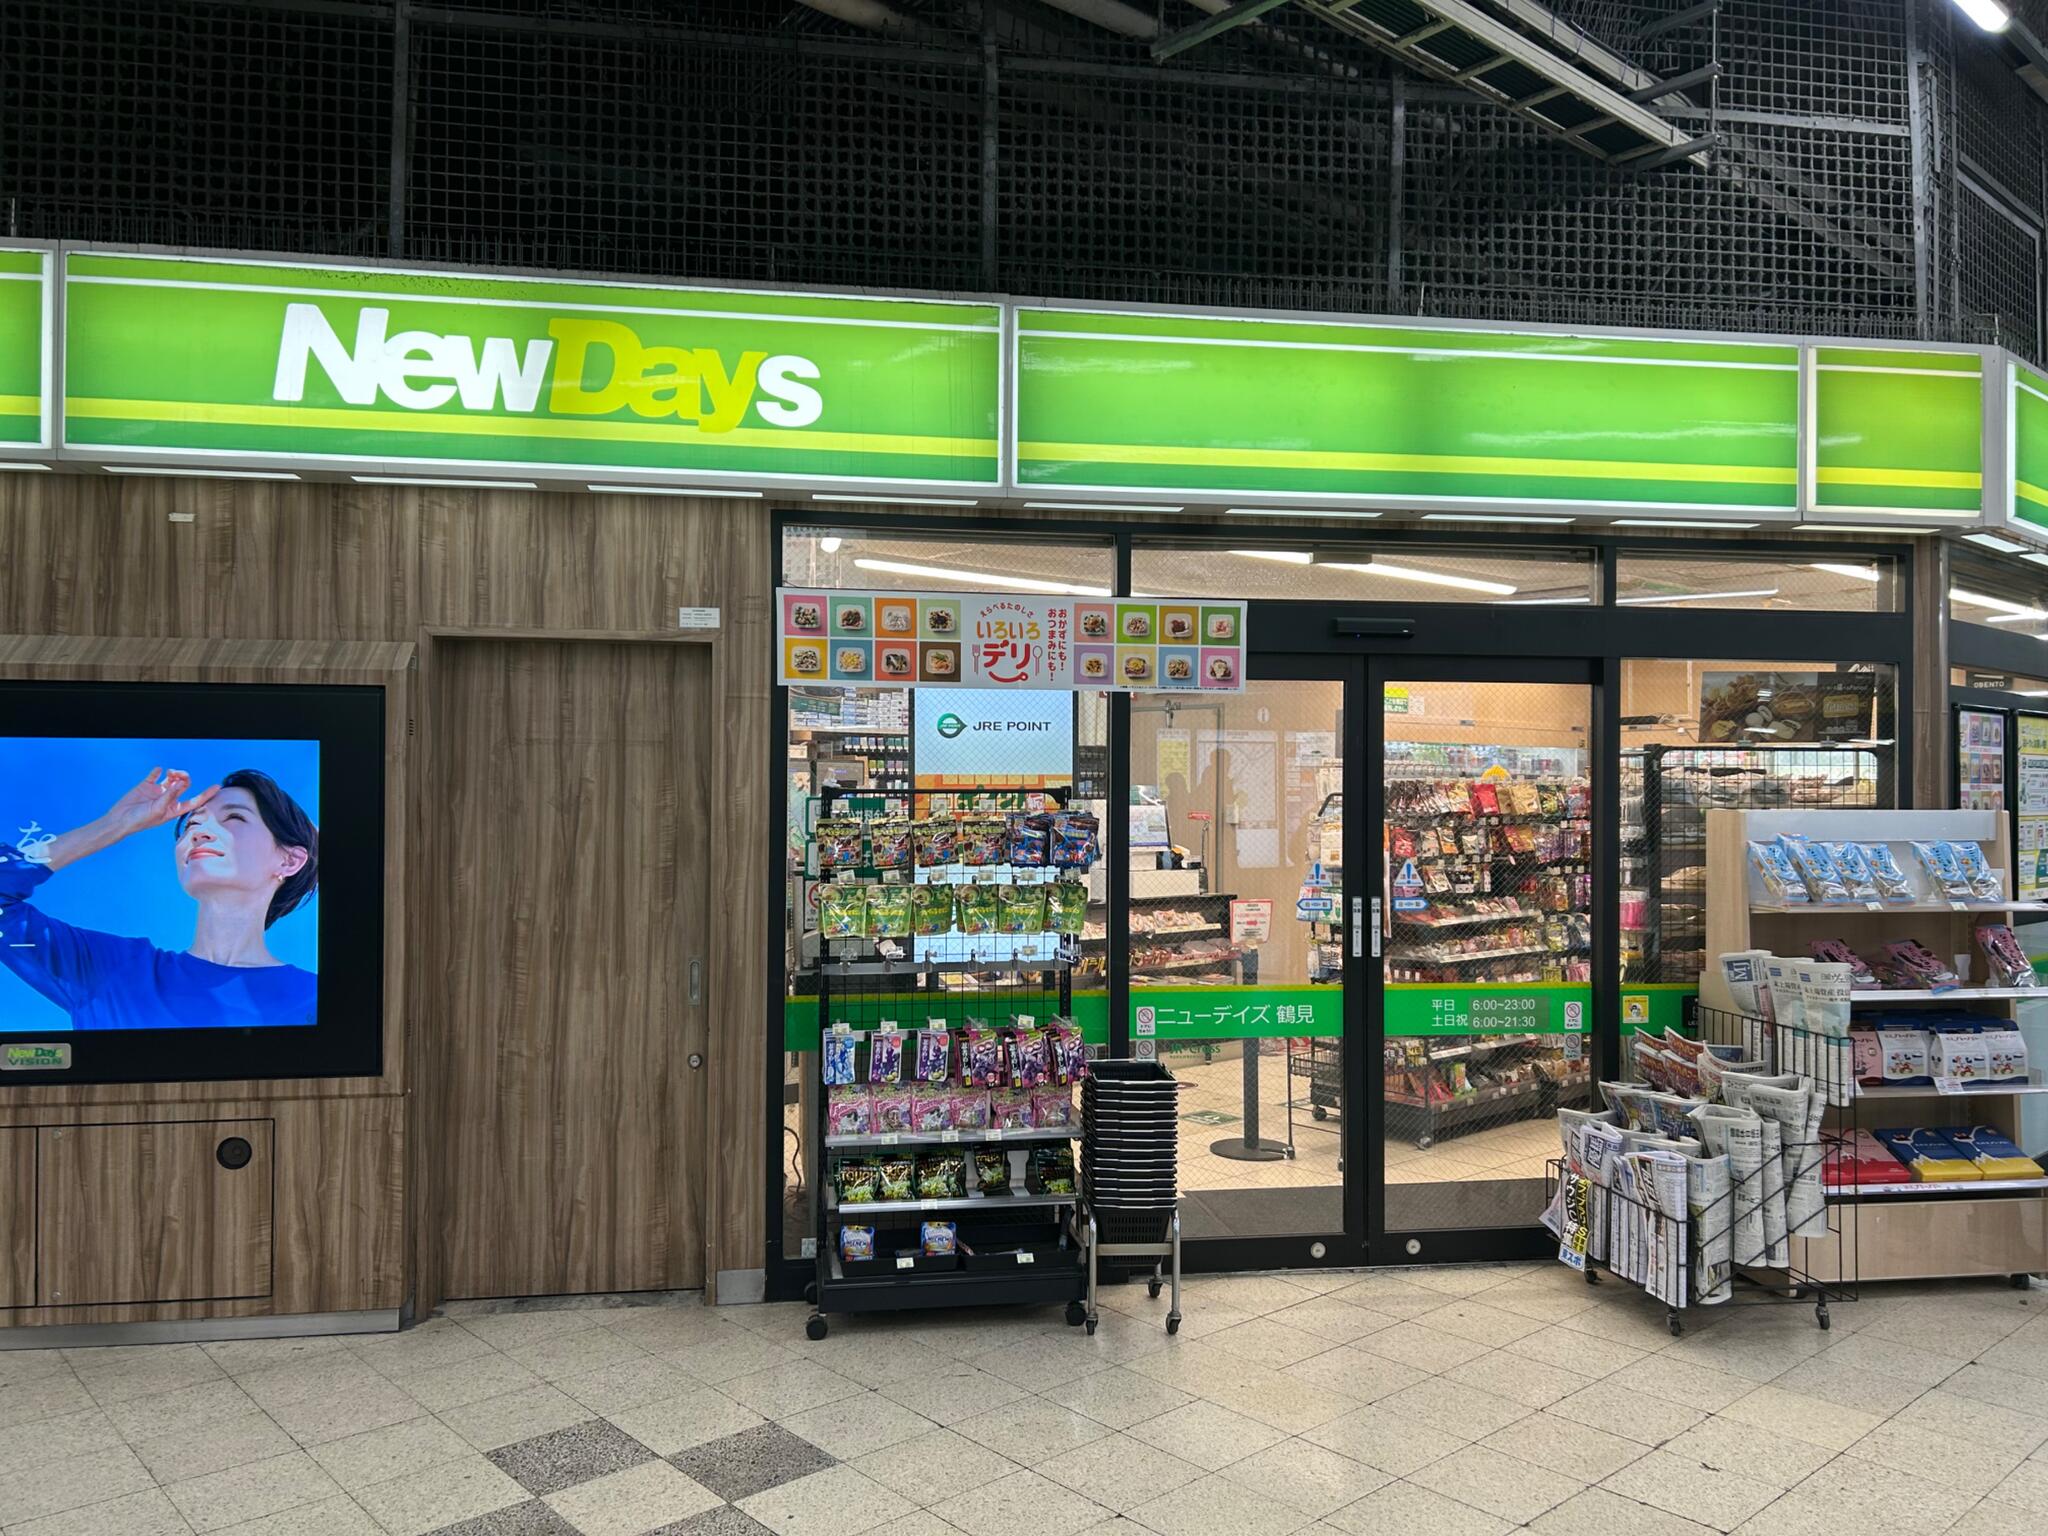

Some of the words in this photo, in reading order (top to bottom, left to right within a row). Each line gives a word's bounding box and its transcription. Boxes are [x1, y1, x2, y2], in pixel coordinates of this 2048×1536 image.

[273, 303, 823, 433] NewDays
[980, 602, 1035, 618] えらべるたのしさ
[976, 621, 1041, 640] いろいろ
[983, 640, 1031, 670] デリ
[973, 721, 1002, 731] JRE
[1007, 721, 1052, 731] POINT
[1431, 999, 1455, 1012] 平日
[1472, 999, 1536, 1011] 6:00~23:00
[1157, 1004, 1271, 1025] ニューデイズ
[1276, 1004, 1315, 1025] 鶴見
[1431, 1014, 1468, 1027] 土日祝
[1472, 1016, 1536, 1028] 6:00~21:30
[7, 1047, 65, 1058] NewDays
[8, 1057, 63, 1066] VISION
